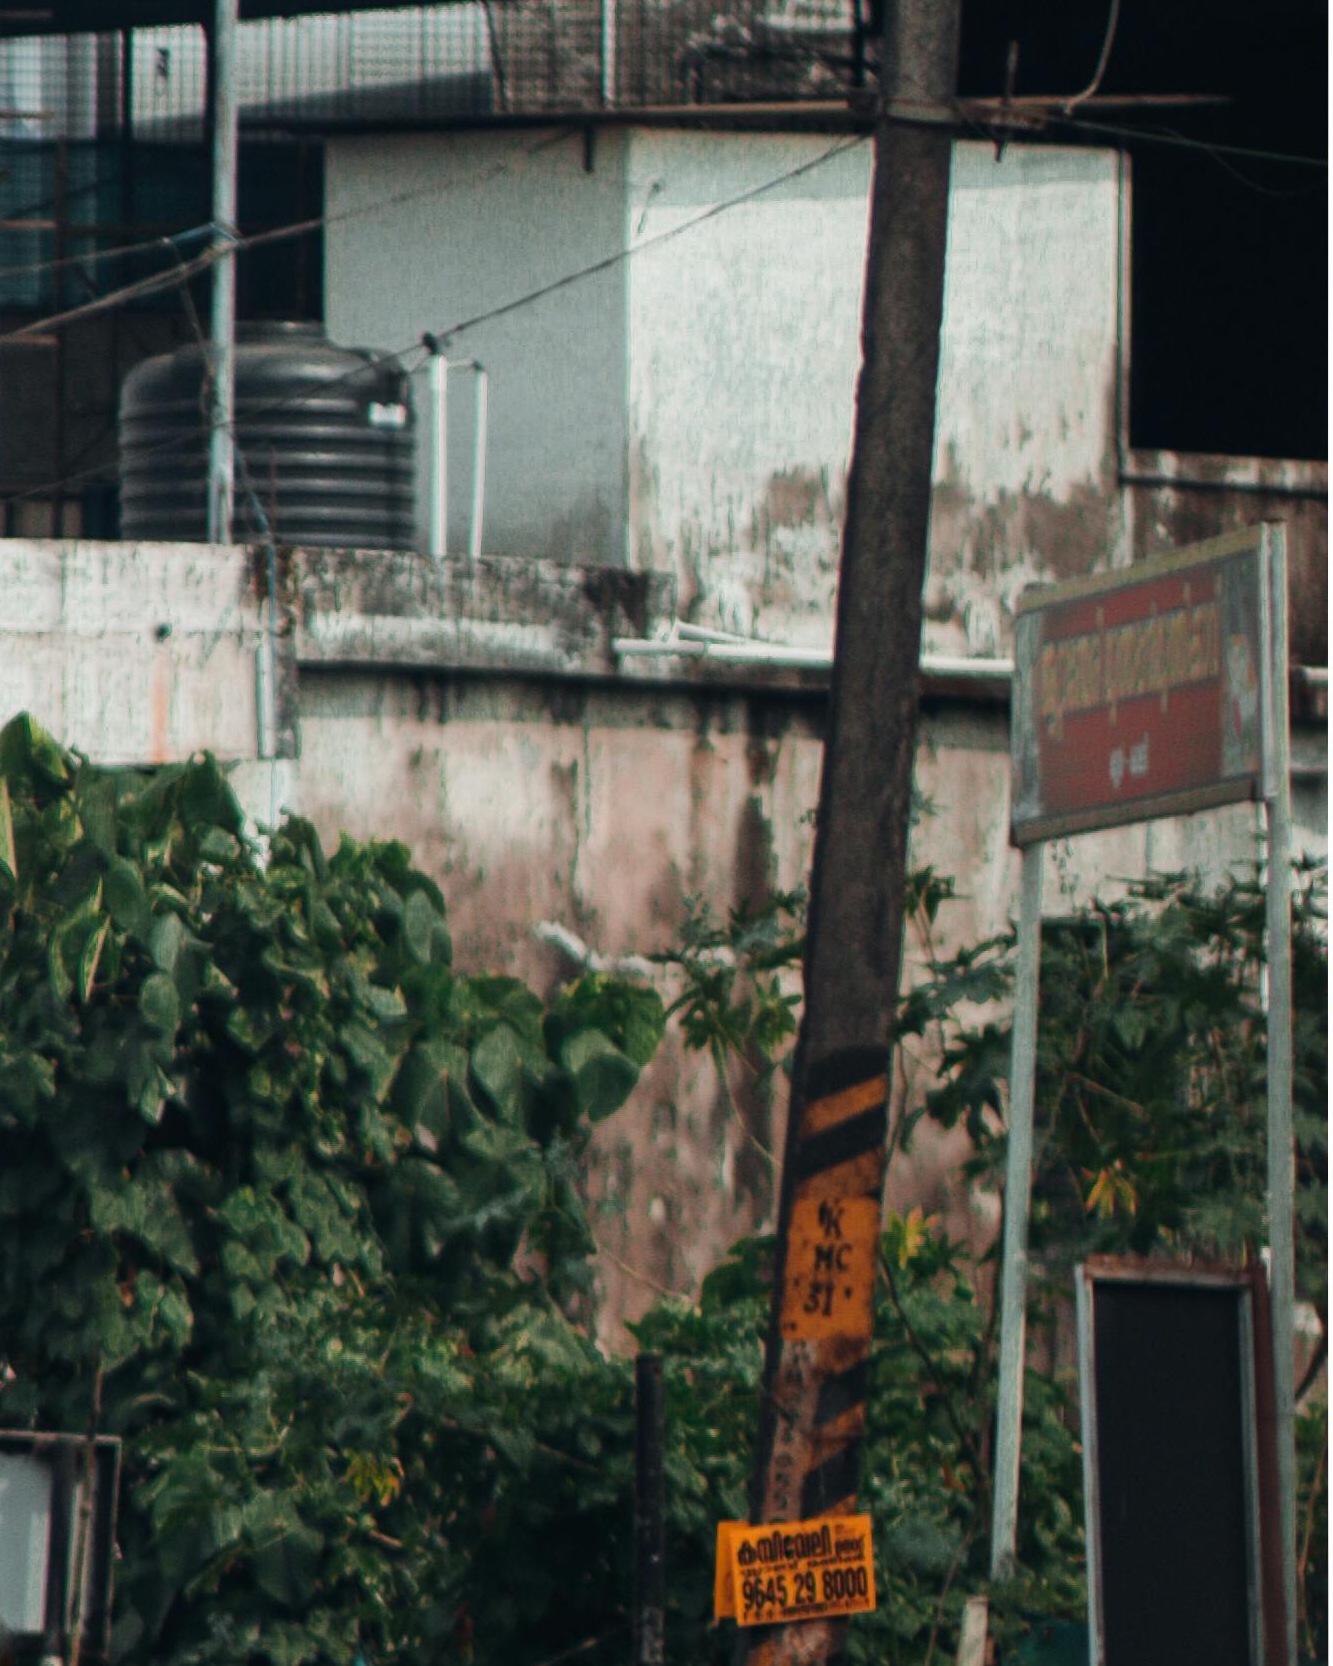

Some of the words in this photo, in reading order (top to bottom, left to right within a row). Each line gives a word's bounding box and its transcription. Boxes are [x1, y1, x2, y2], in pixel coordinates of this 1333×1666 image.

[742, 1574, 788, 1611] 9645
[793, 1570, 817, 1605] 29
[822, 1565, 868, 1601] 8000
